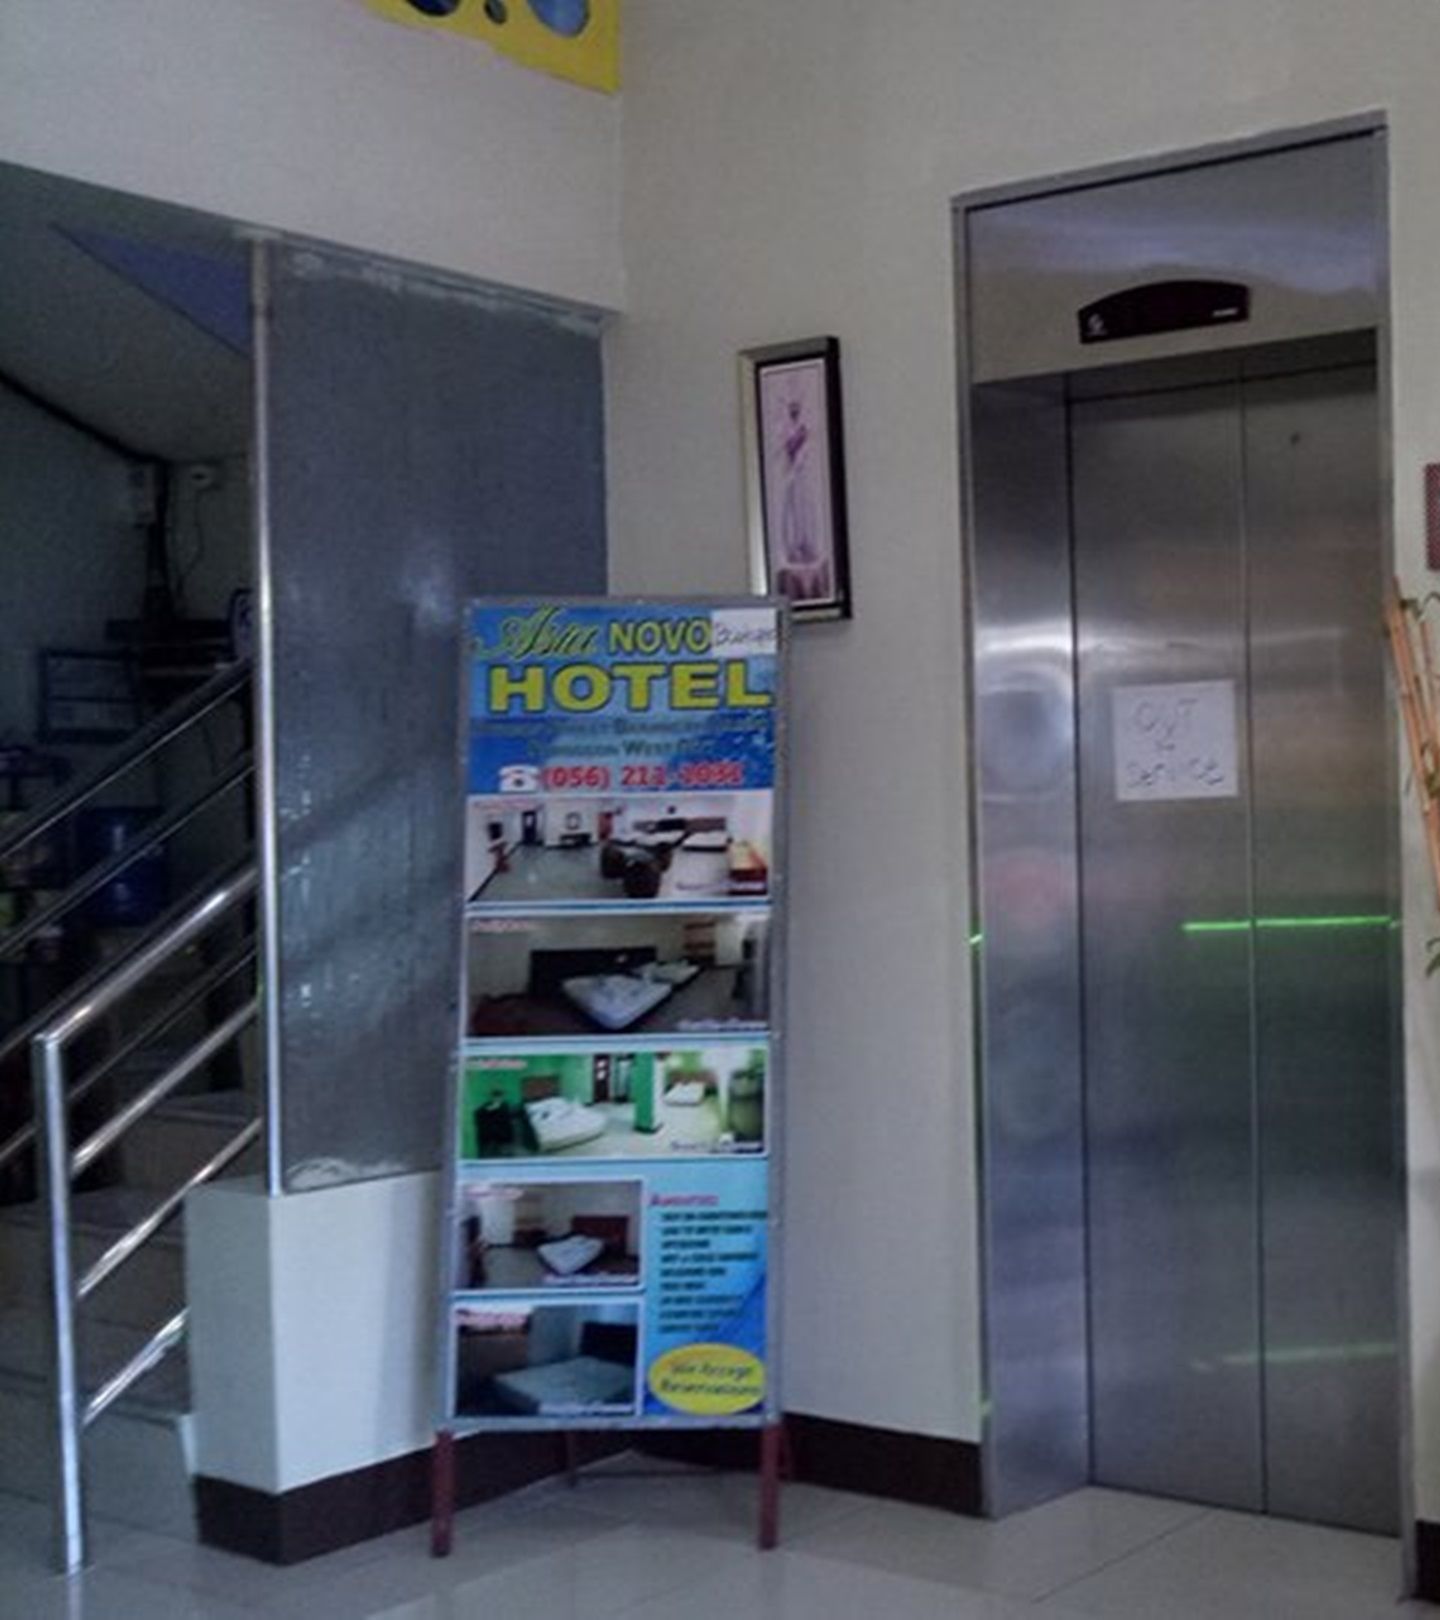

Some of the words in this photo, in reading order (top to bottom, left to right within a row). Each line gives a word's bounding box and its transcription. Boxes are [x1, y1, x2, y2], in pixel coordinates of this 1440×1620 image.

[476, 606, 598, 660] Asia
[609, 616, 712, 655] NOVO
[489, 661, 773, 713] HOTEL
[542, 764, 611, 791] (056)
